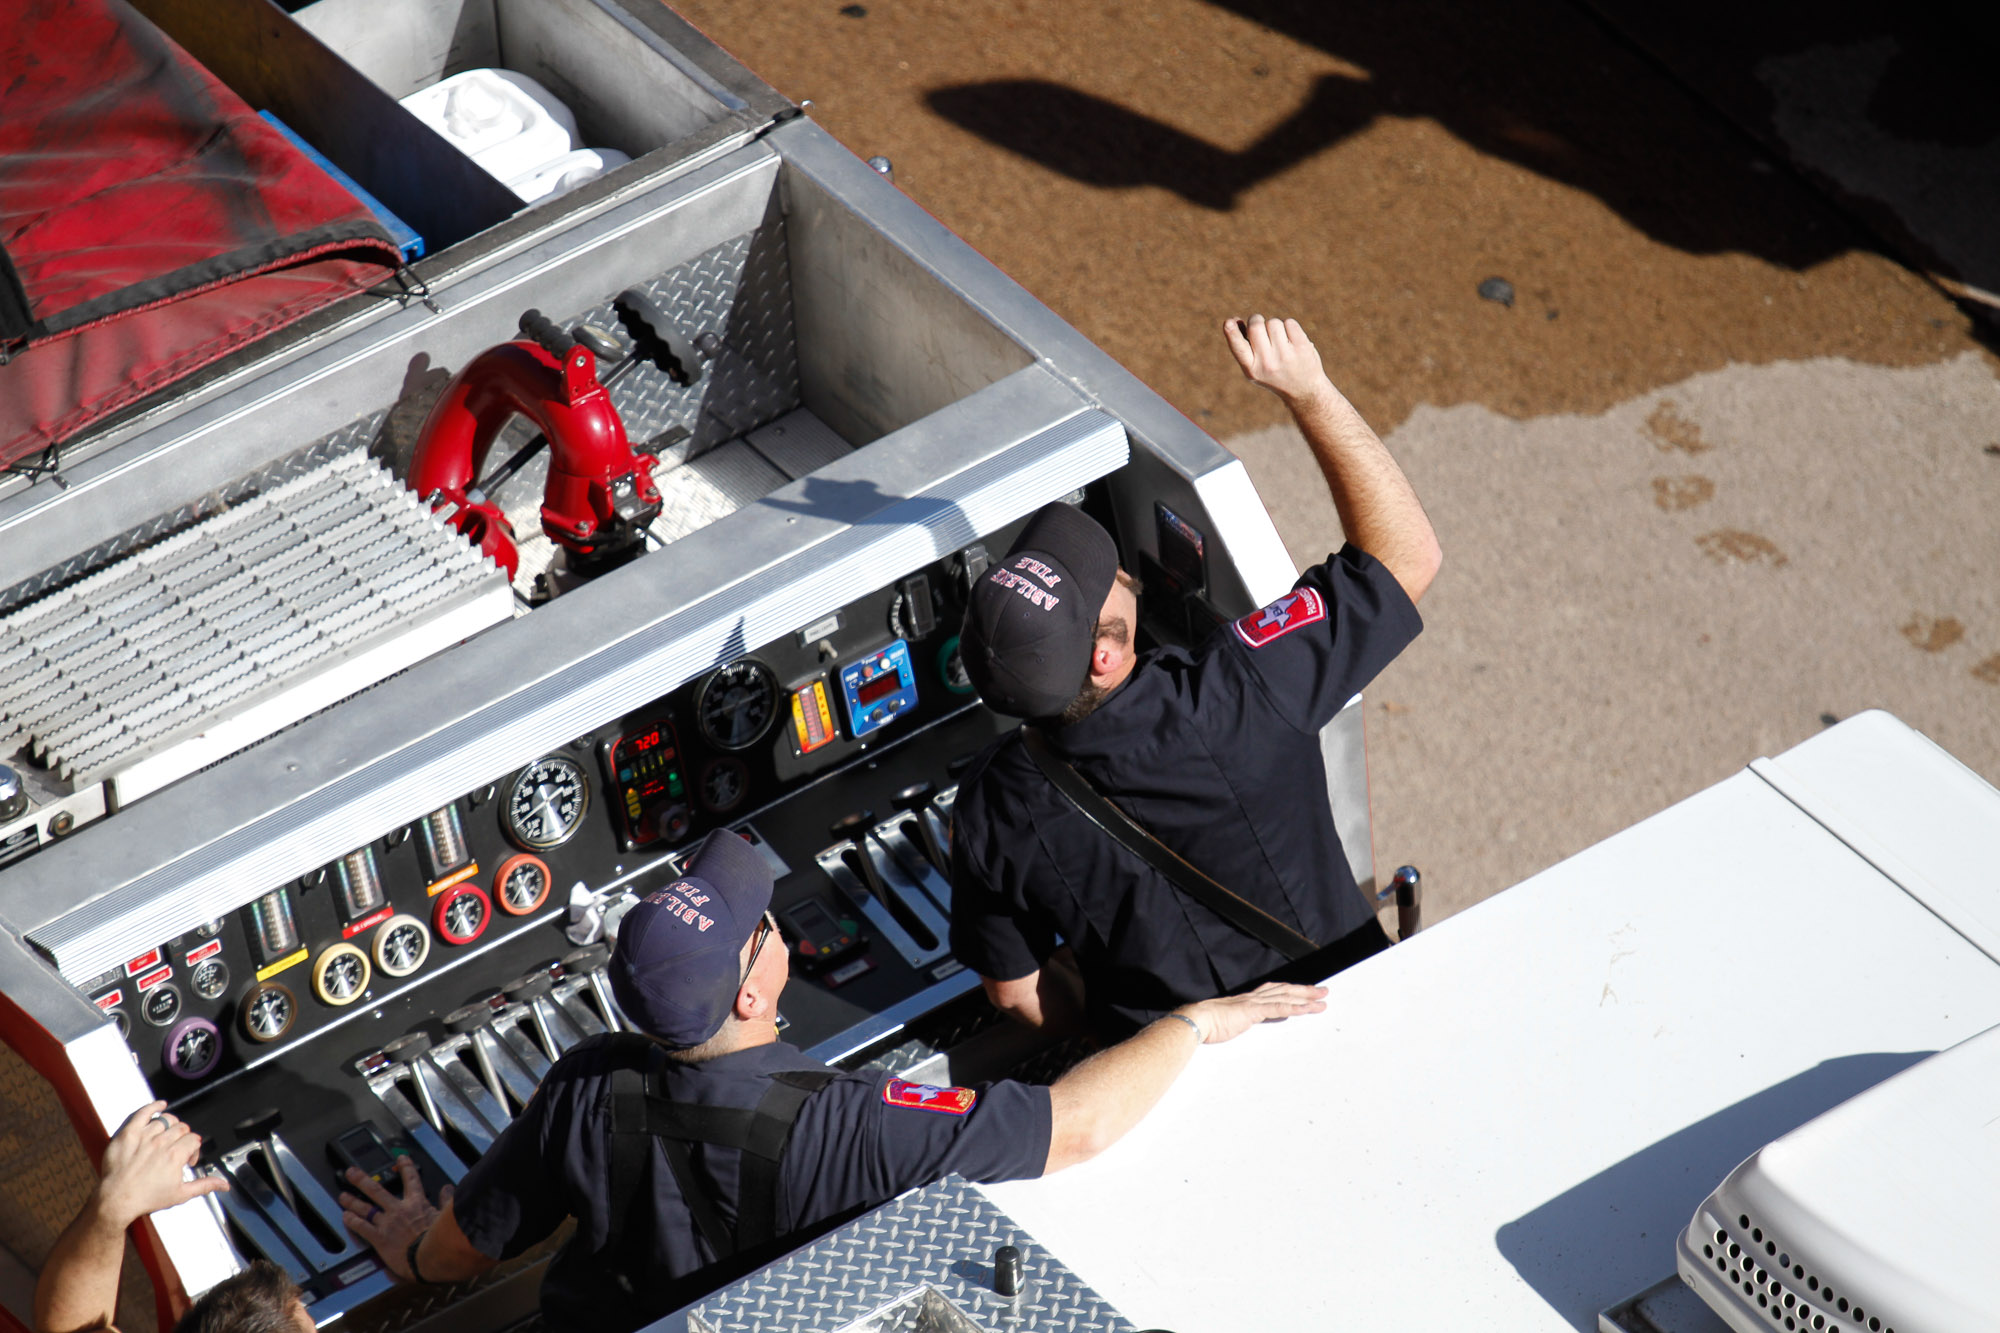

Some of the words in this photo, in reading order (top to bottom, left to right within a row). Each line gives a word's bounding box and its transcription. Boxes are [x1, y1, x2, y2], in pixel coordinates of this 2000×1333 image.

[1014, 556, 1062, 588] FIRE
[635, 731, 660, 751] 720
[664, 882, 711, 907] FIR
[643, 891, 715, 932] ABILE
